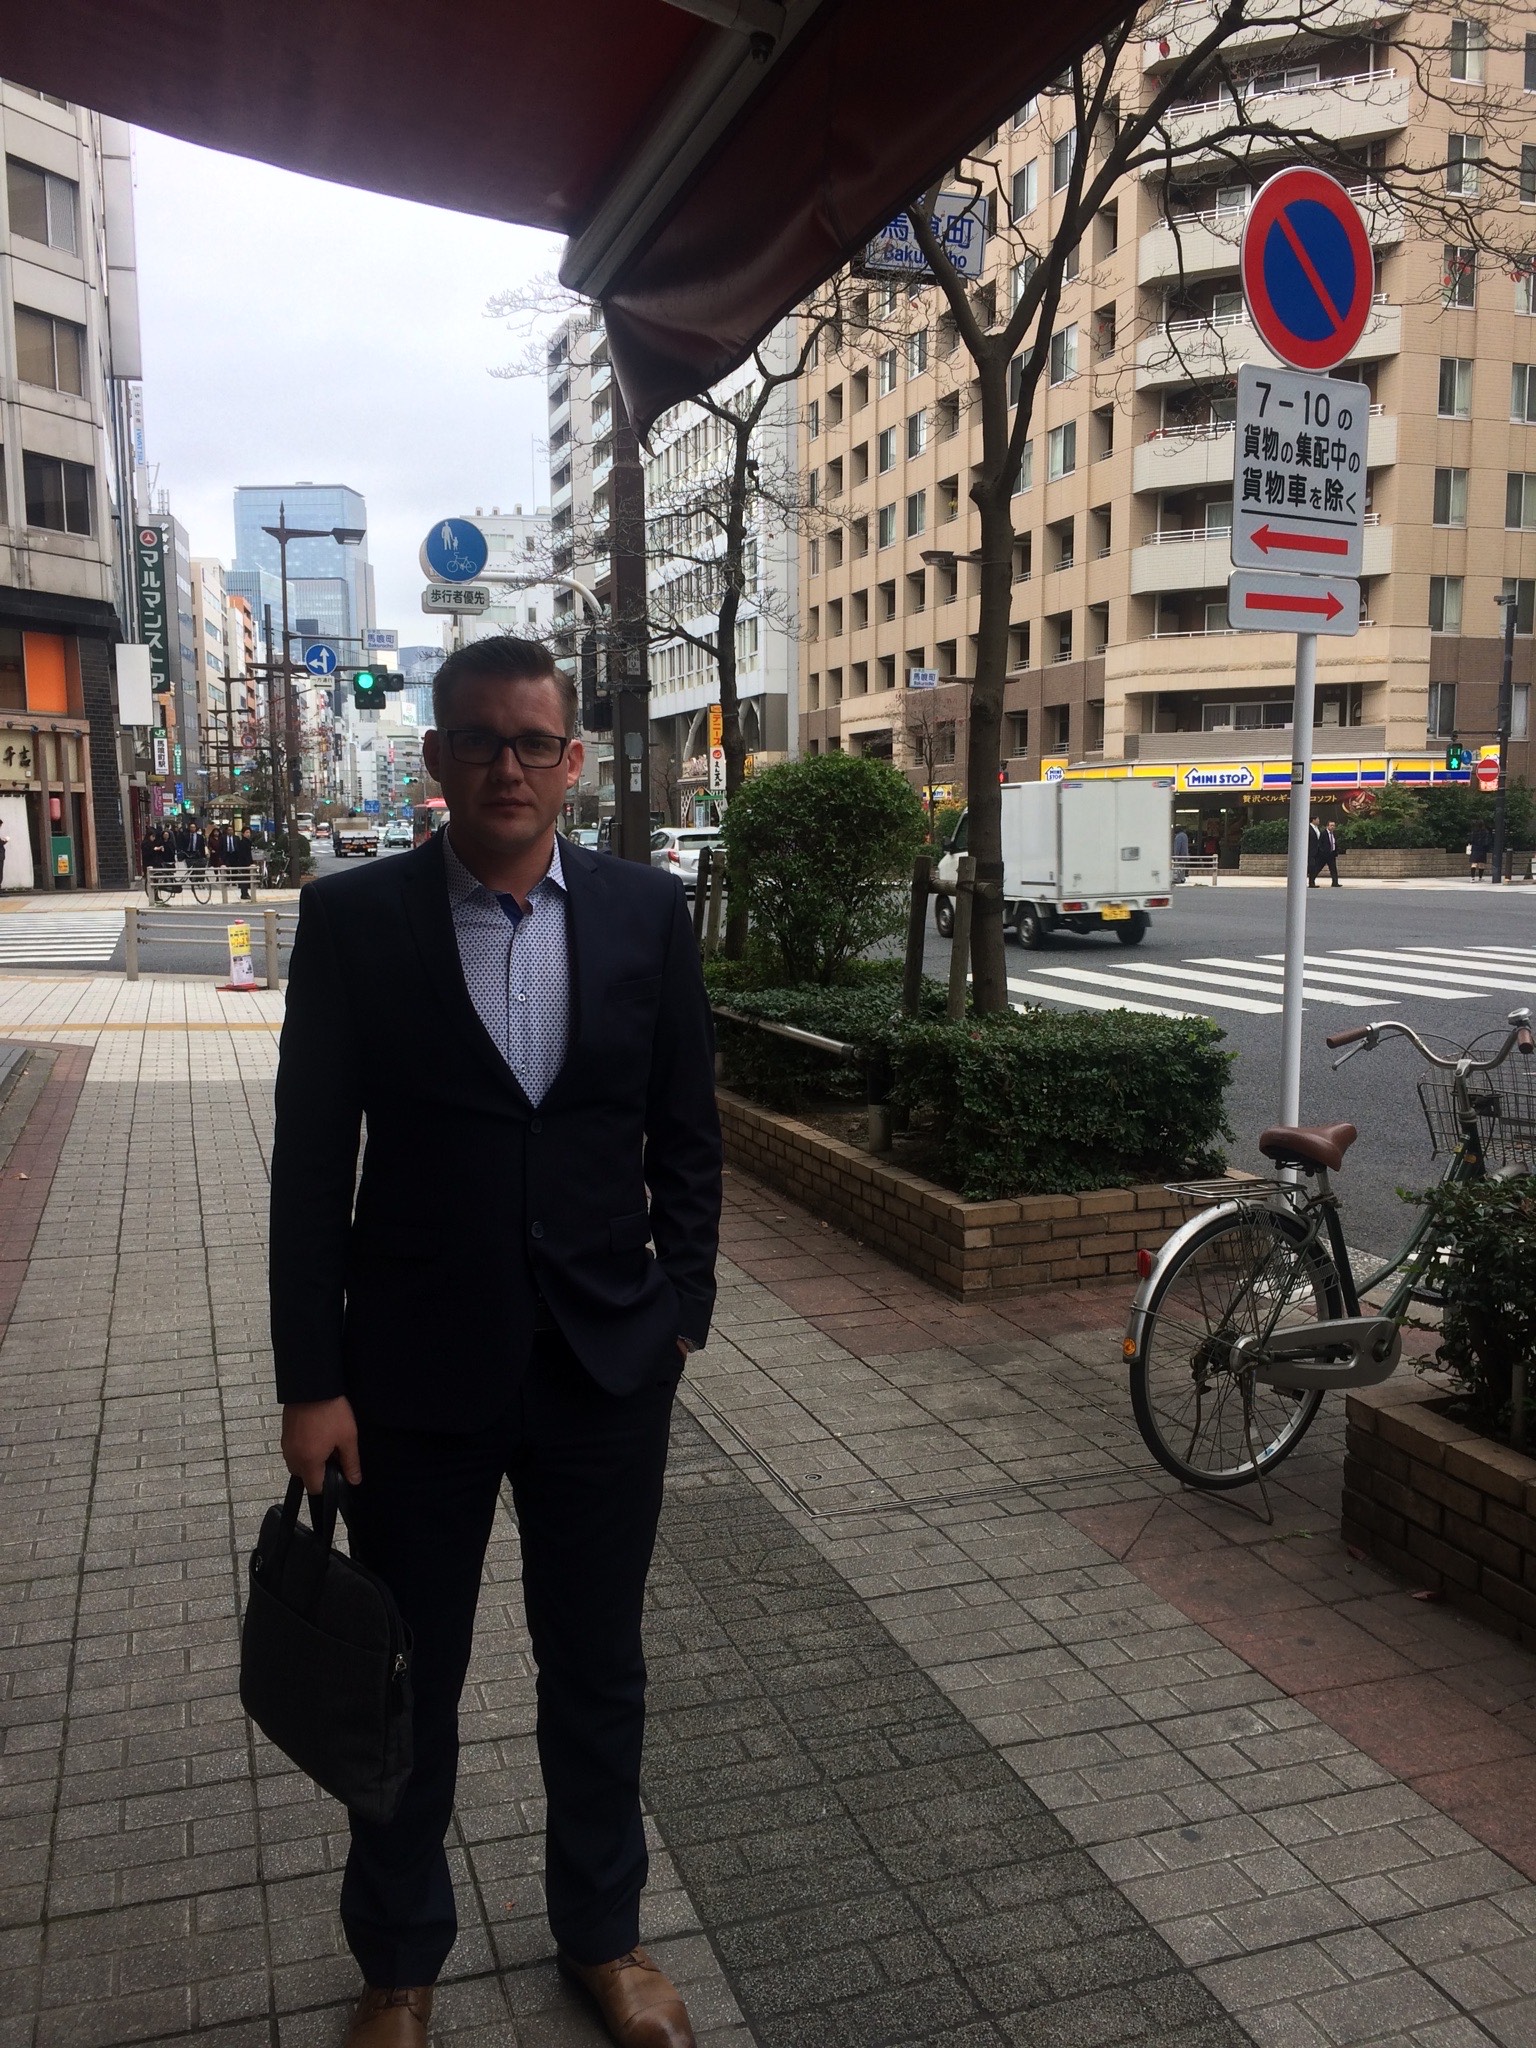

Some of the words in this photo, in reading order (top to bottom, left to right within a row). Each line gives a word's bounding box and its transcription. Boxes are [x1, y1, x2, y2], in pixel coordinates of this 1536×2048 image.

[1243, 423, 1360, 473] 貨物の集配中の
[1241, 466, 1356, 515] 貨物車を除く
[431, 589, 485, 605] 歩行者優先
[140, 550, 165, 689] マルマンストア
[367, 633, 395, 644] 馬喰町
[913, 672, 936, 681] 馬喰町
[3, 745, 31, 767] 千吉
[157, 740, 166, 767] 馬喰町駅
[1192, 774, 1217, 784] MINI
[1219, 773, 1248, 783] STOP
